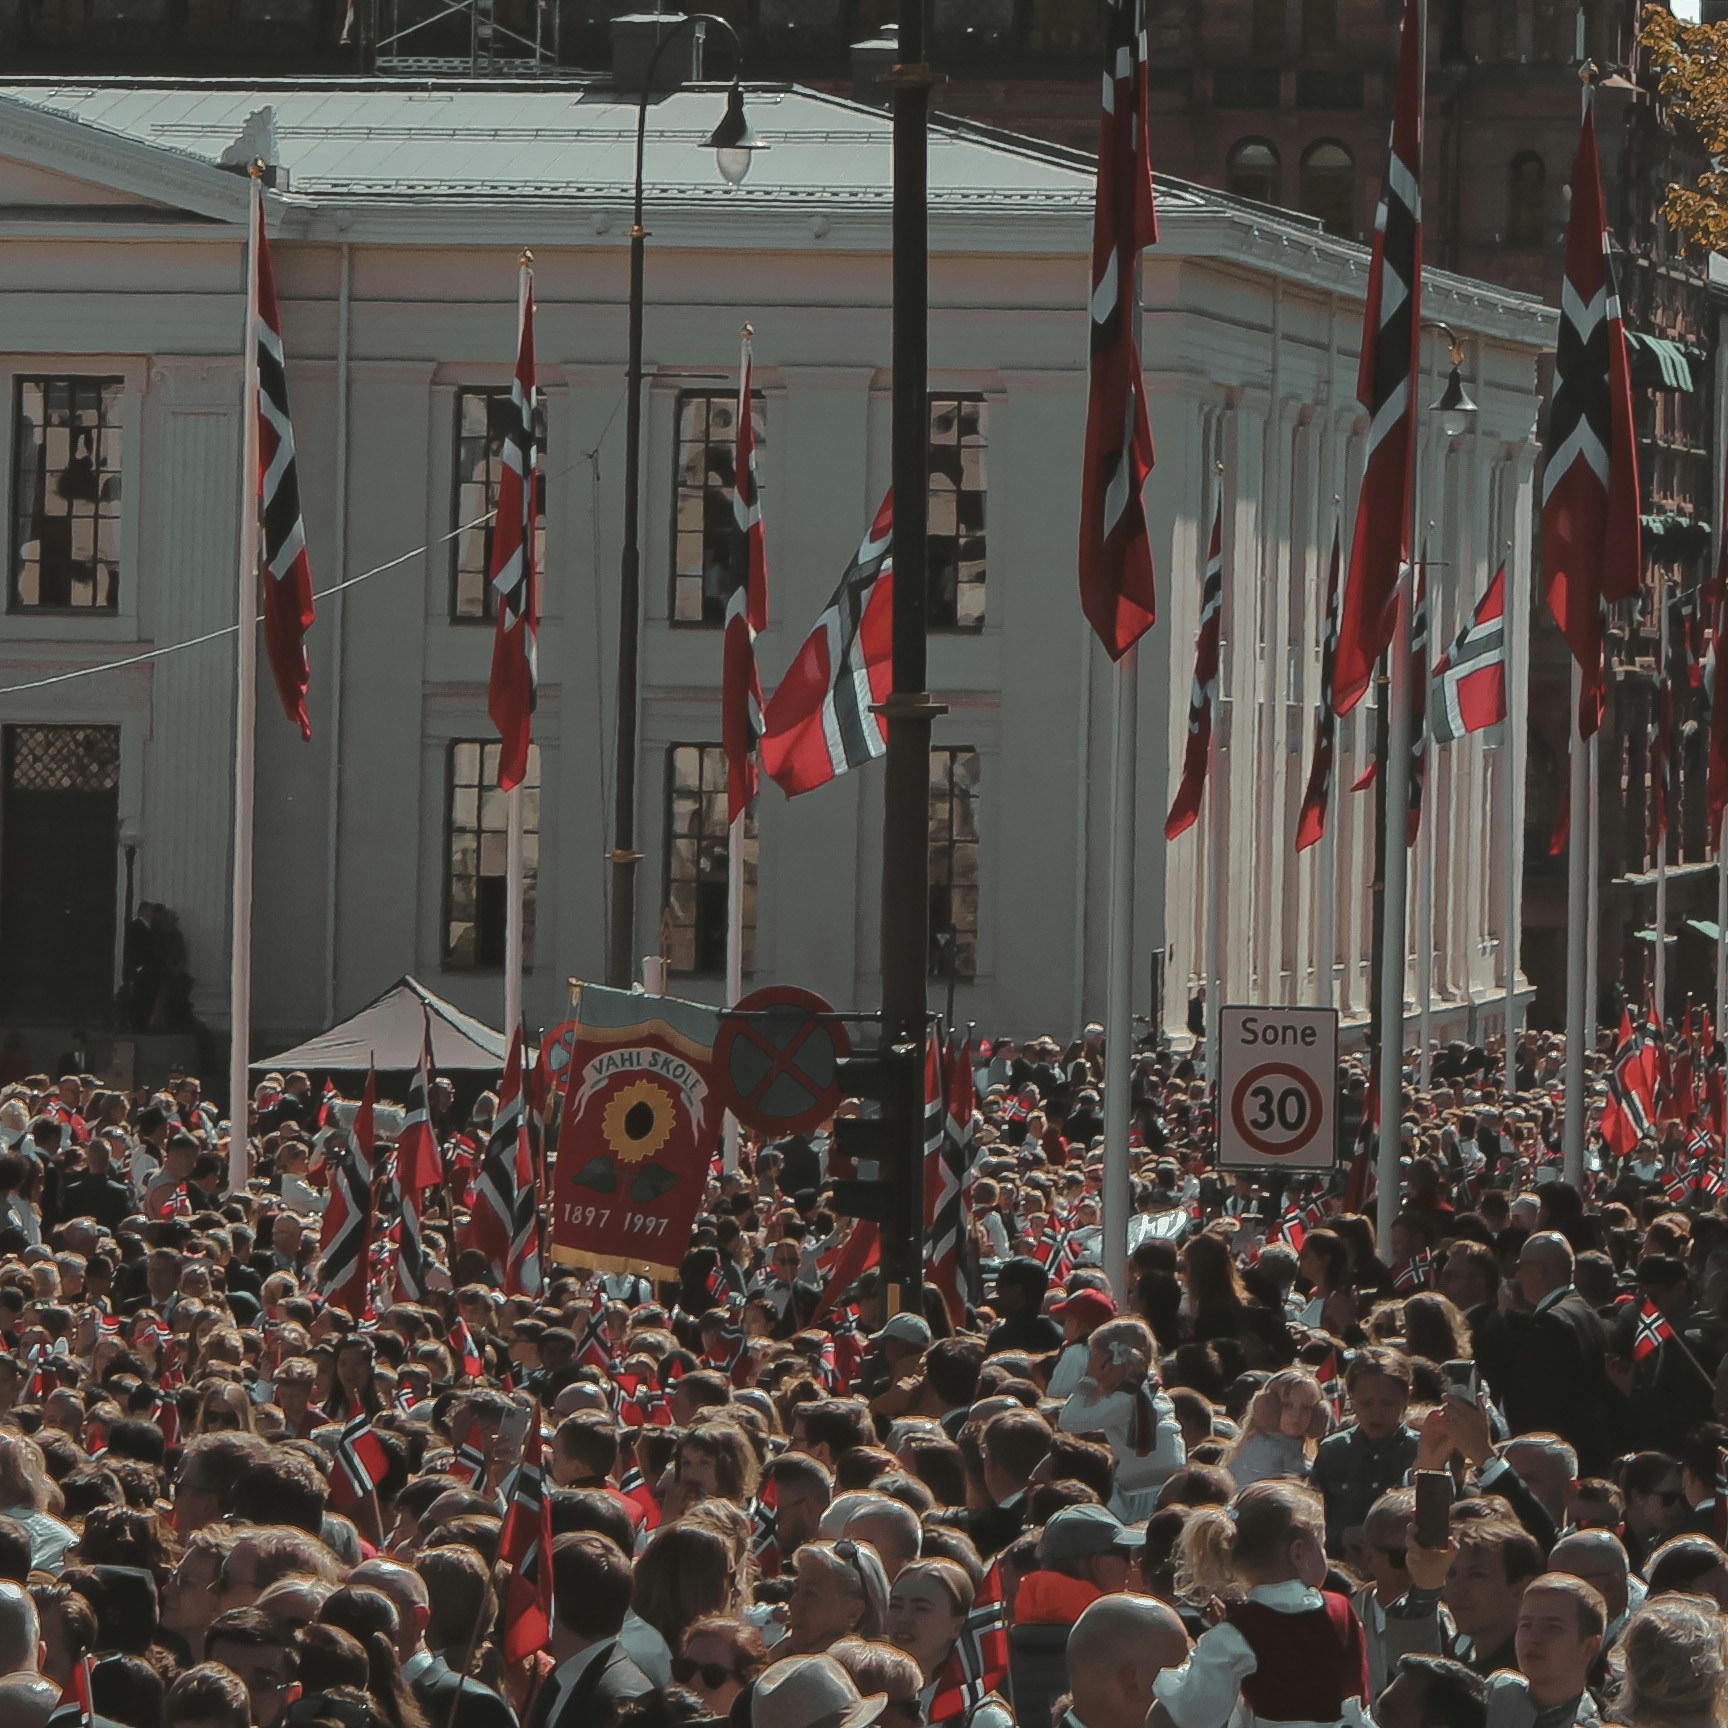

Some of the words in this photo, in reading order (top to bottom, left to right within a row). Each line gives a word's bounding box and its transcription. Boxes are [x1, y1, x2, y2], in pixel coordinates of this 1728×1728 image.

[1241, 1017, 1317, 1046] Sone
[648, 1052, 702, 1093] SKOLE
[1249, 1086, 1307, 1131] 30
[565, 1203, 611, 1229] 1897
[623, 1212, 669, 1237] 1997
